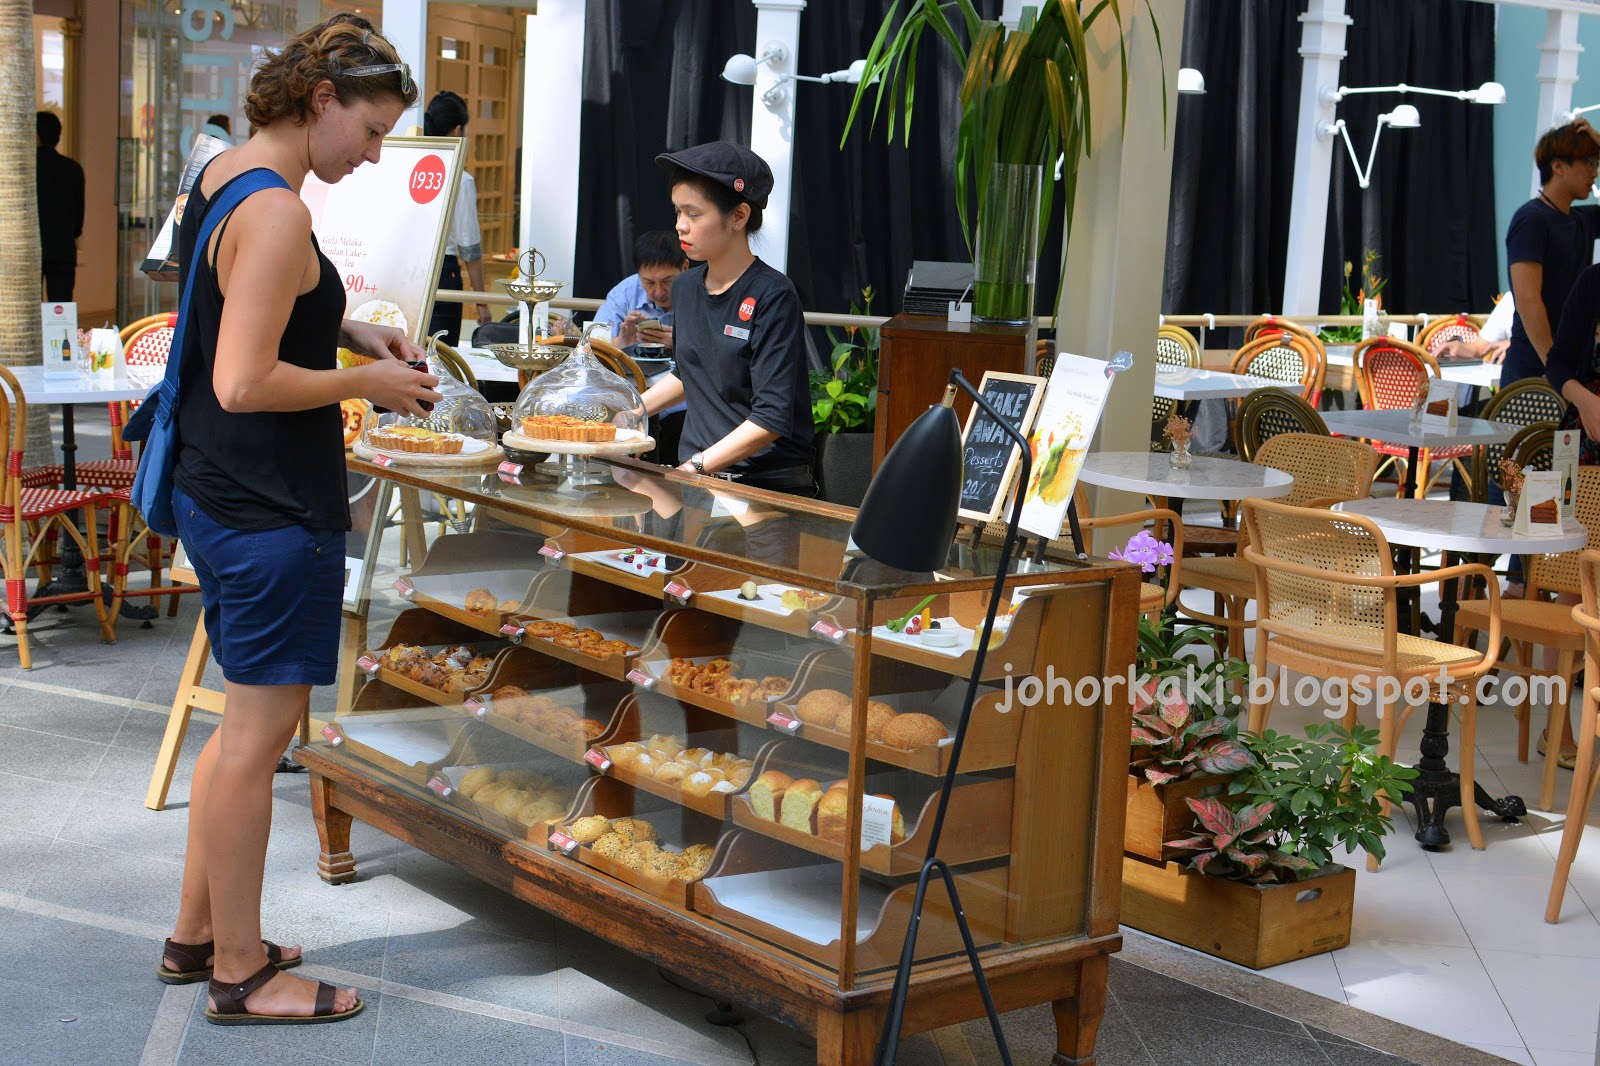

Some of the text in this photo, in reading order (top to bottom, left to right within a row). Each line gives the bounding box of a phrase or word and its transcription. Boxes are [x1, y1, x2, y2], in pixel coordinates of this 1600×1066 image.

[411, 171, 443, 190] 1933
[345, 248, 362, 258] Cake
[344, 258, 355, 268] Tea
[739, 302, 754, 315] 1933
[983, 390, 1028, 418] TAKE
[963, 447, 1004, 468] Desserts
